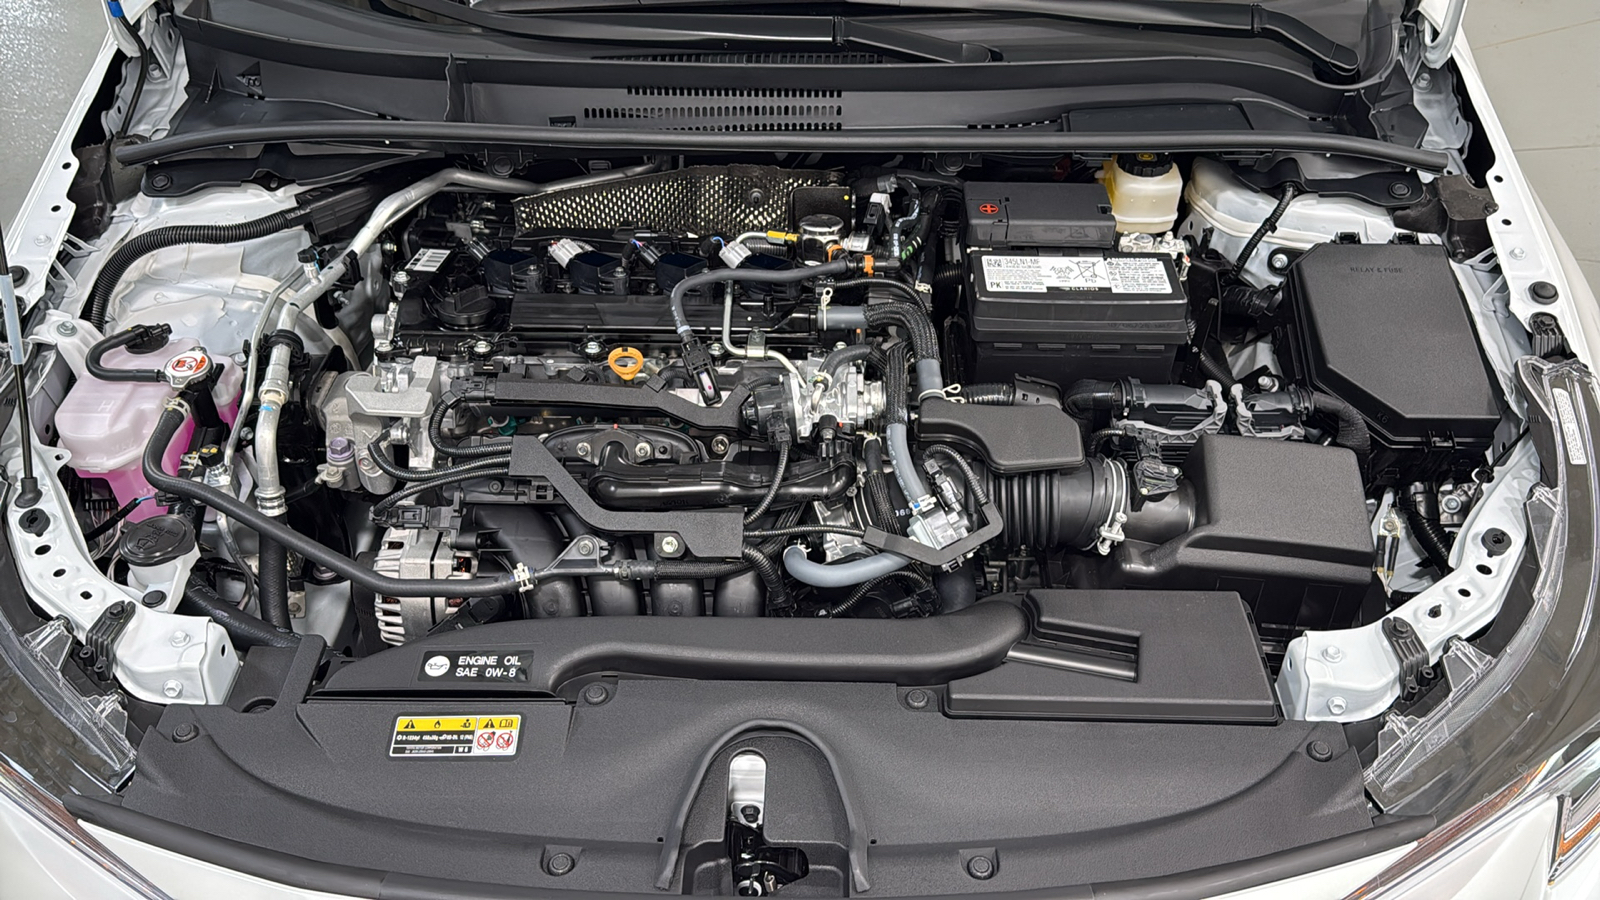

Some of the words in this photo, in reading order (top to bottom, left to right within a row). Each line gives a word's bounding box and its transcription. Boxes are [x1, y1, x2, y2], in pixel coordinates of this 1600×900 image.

[457, 655, 498, 666] ENGINE
[503, 655, 522, 666] OIL
[455, 667, 478, 677] SAE
[485, 667, 517, 677] 0W-8
